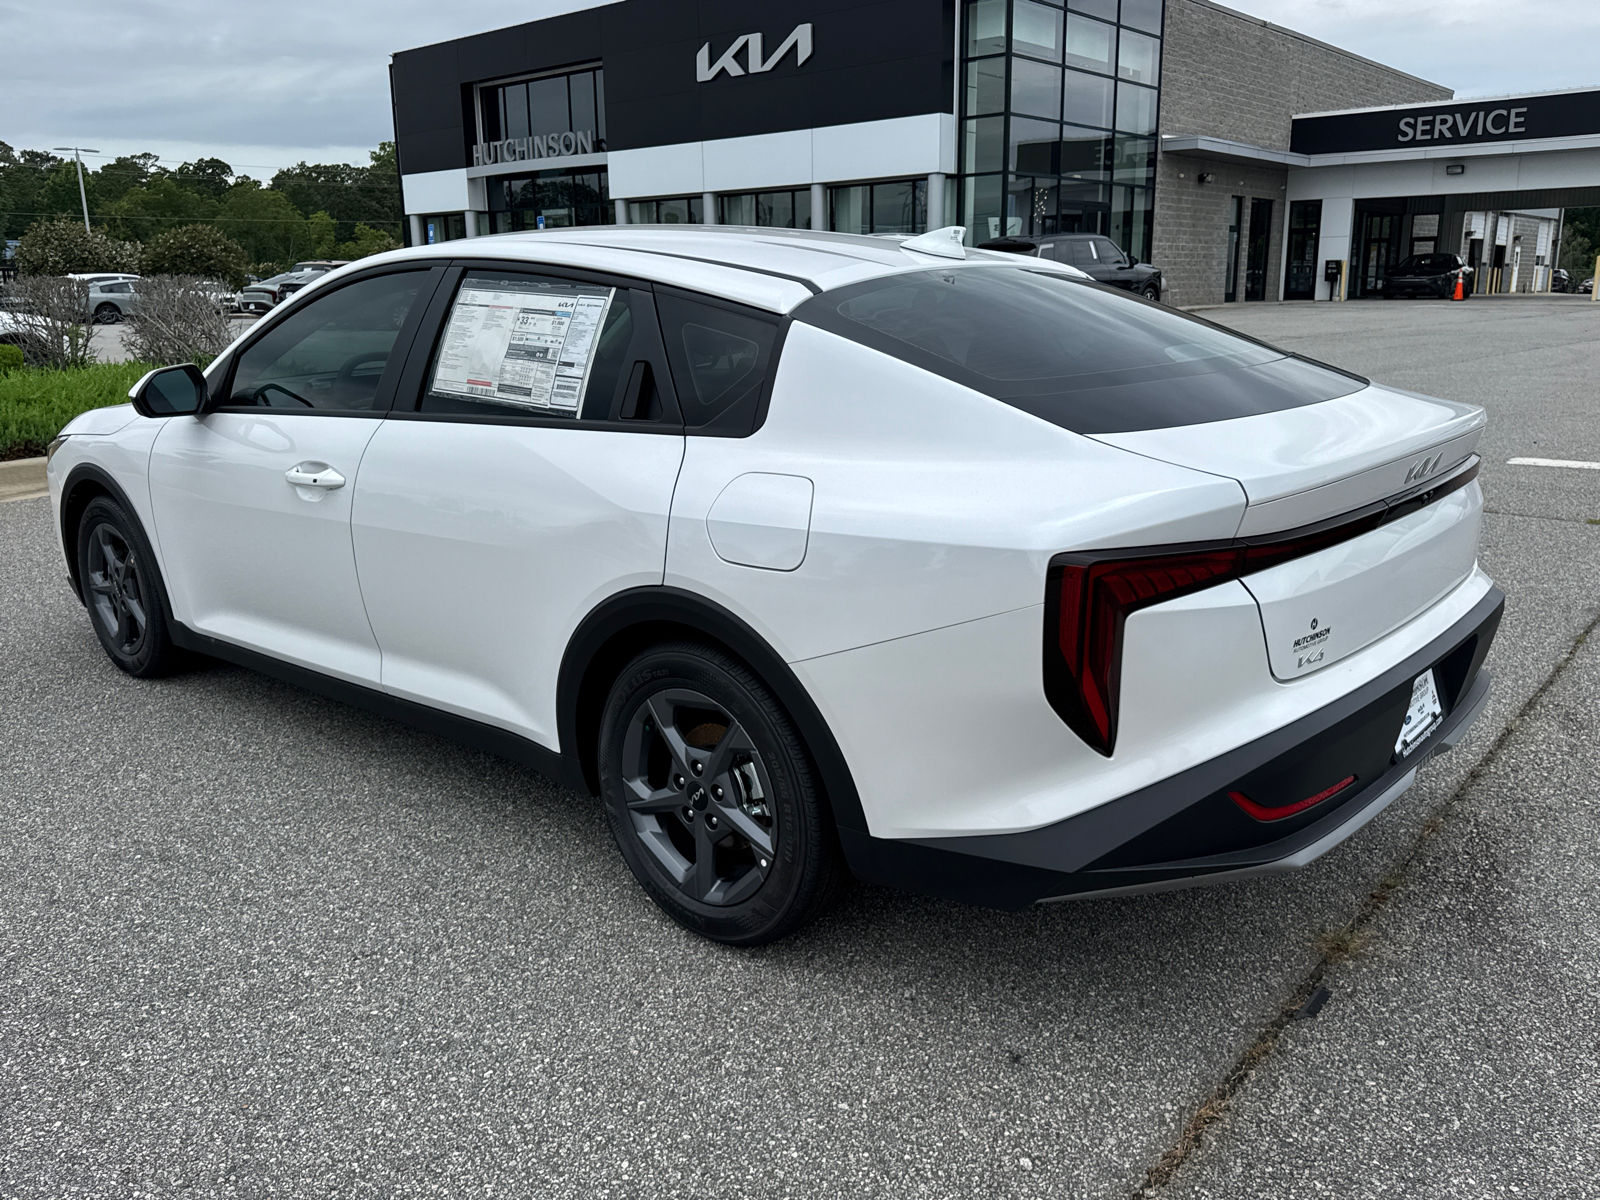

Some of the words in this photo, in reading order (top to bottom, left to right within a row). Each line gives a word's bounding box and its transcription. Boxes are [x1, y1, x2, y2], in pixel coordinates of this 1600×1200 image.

[696, 22, 813, 83] KIA
[1398, 107, 1528, 142] SERVICE
[473, 130, 593, 166] HUTCHINSON
[1404, 452, 1443, 484] KIA
[1292, 627, 1331, 648] HUTCHINSON
[1292, 641, 1317, 653] AUTOMOTIVE
[1317, 636, 1329, 645] GROUP
[1297, 647, 1324, 668] K4
